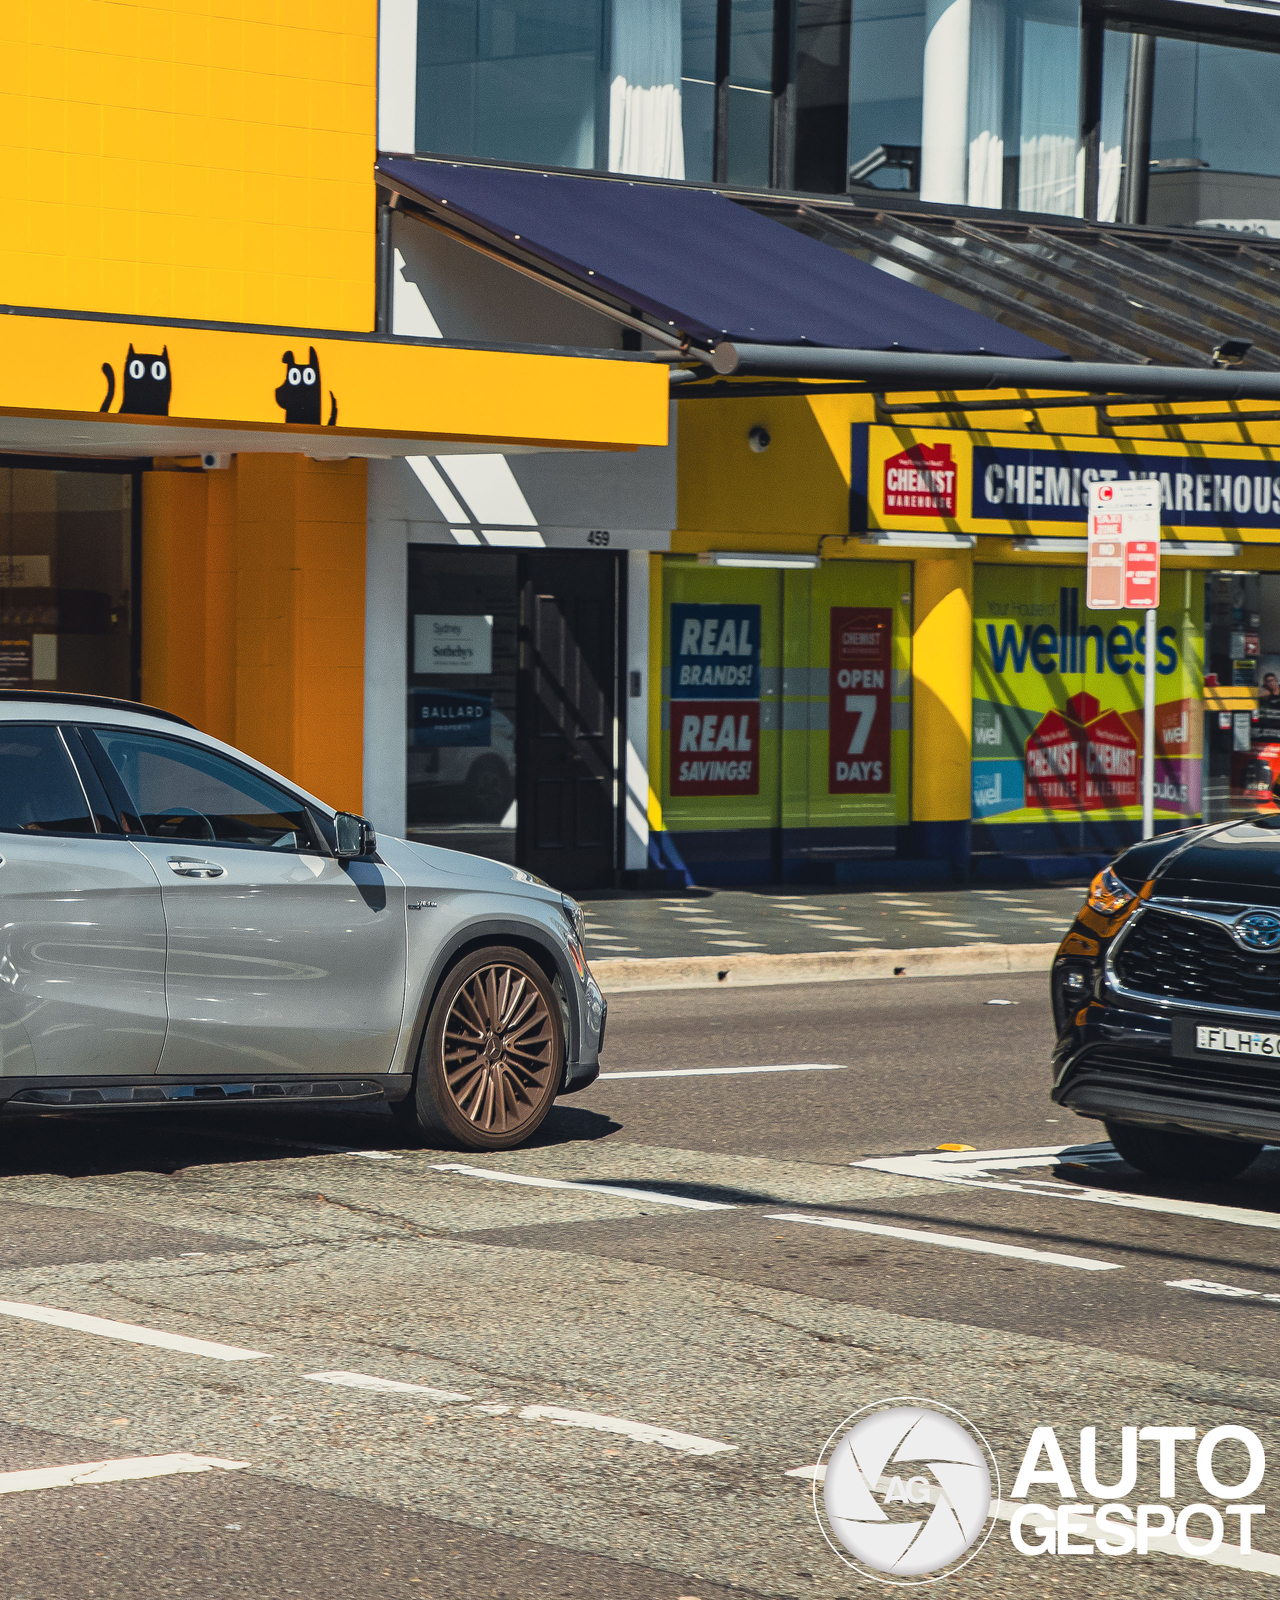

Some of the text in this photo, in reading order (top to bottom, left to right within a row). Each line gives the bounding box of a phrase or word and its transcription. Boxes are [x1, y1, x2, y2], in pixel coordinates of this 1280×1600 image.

[887, 468, 955, 493] CHEMIST
[887, 494, 952, 509] WAREHOUSE
[587, 530, 610, 546] 459
[679, 619, 753, 656] REAL
[842, 632, 880, 645] CHEMIST
[986, 587, 1179, 675] wellness
[679, 664, 752, 686] BRANDS!
[837, 669, 884, 689] OPEN
[422, 706, 484, 718] BALLARD
[845, 695, 877, 754] 7
[679, 715, 752, 752] REAL
[974, 714, 1002, 746] well
[1162, 711, 1188, 744] well
[678, 761, 752, 781] SAVINGS!
[836, 761, 883, 781] DAYS
[1026, 741, 1078, 778] CHEMIST
[1086, 741, 1136, 776] CHEMIST
[974, 773, 1002, 807] well
